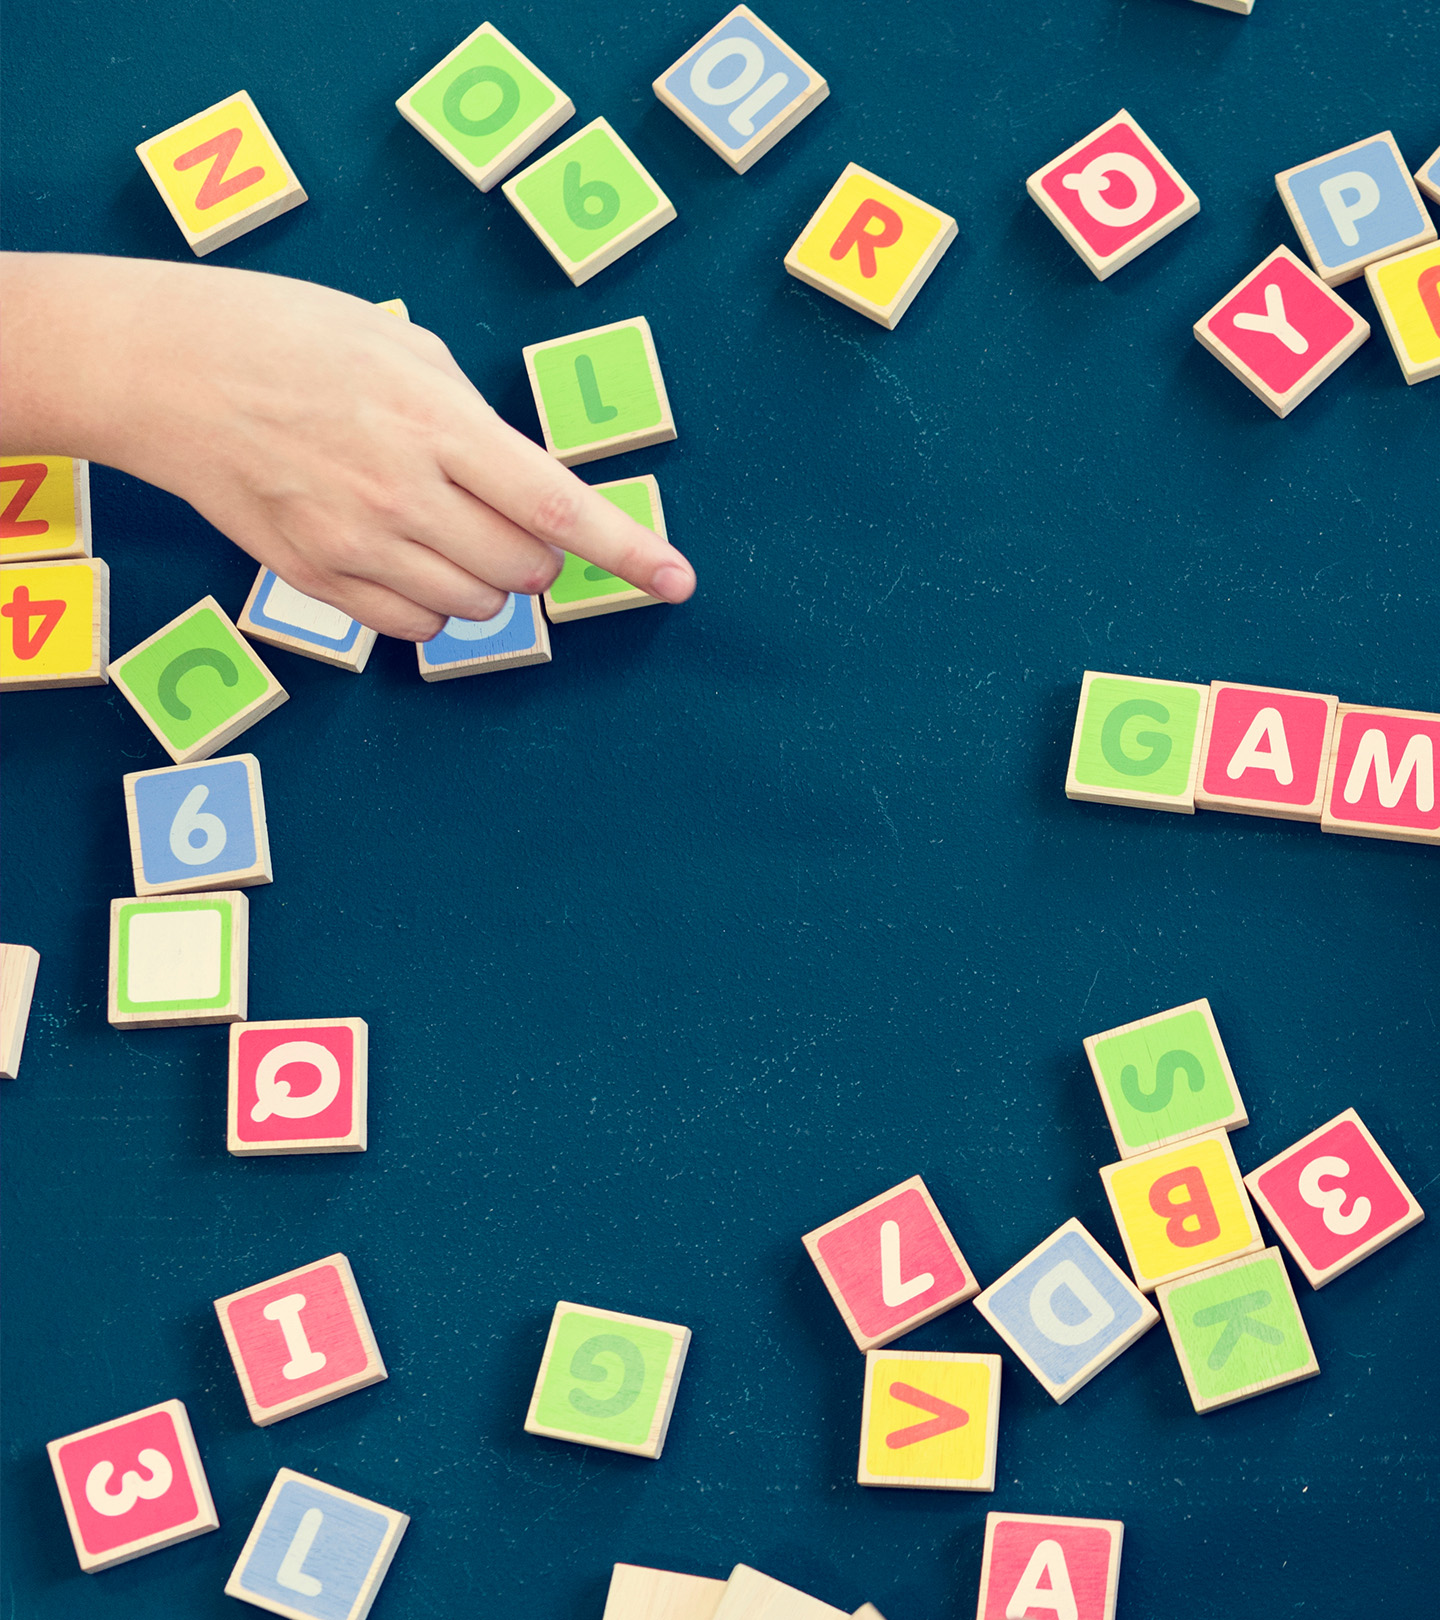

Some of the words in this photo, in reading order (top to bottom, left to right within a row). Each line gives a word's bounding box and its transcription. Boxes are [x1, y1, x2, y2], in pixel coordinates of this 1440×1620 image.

[443, 65, 521, 137] O
[1062, 152, 1157, 227] Q
[1319, 170, 1381, 247] P
[830, 198, 903, 278] R
[1233, 284, 1308, 354] Y
[1, 585, 66, 660] 4
[157, 647, 239, 721] C
[169, 784, 227, 866] 6
[250, 1041, 341, 1122] Q
[1120, 1049, 1206, 1113] S
[1148, 1166, 1221, 1248] B
[1298, 1156, 1372, 1235] 3
[263, 1293, 327, 1380] I
[1028, 1259, 1116, 1347] D
[1192, 1289, 1286, 1371] K
[567, 1334, 646, 1419] G
[276, 1507, 324, 1597] L
[1005, 1539, 1078, 1620] A
